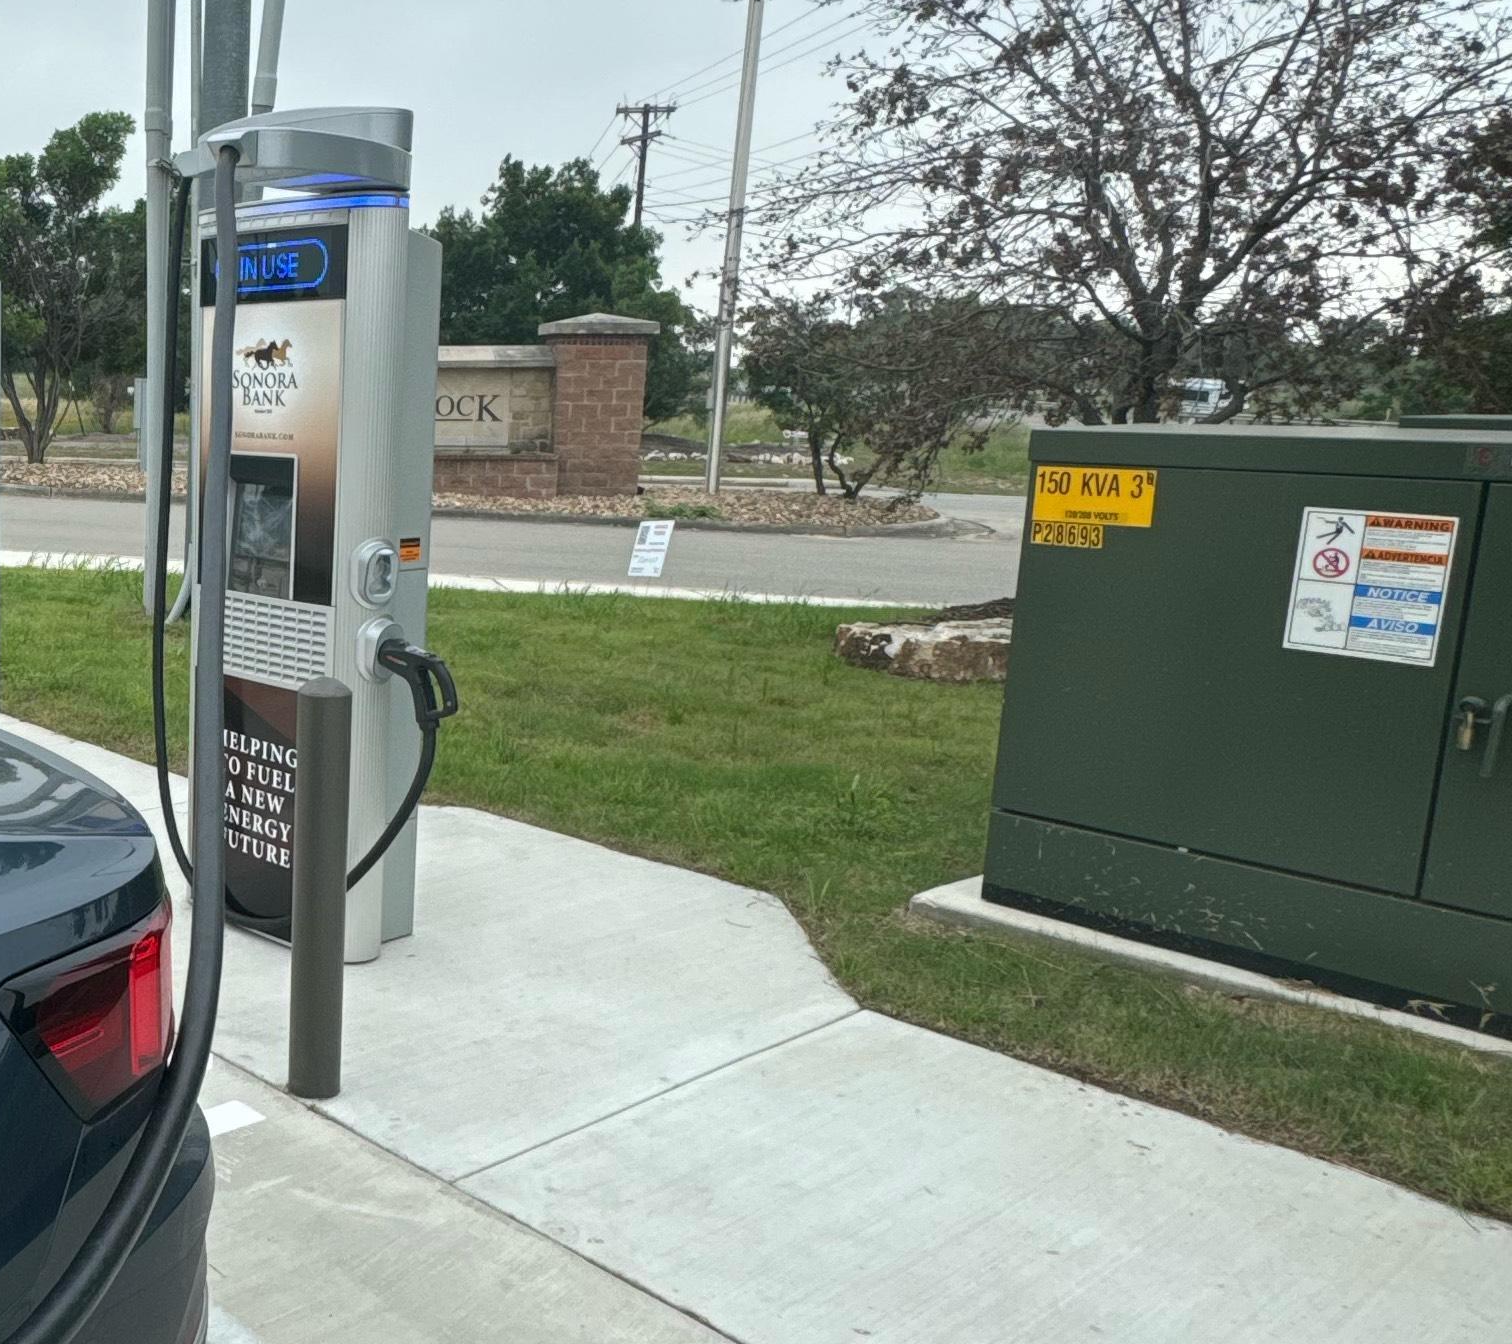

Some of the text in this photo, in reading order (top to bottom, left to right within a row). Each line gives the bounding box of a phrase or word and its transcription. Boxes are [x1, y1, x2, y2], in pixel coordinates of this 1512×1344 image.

[239, 252, 299, 281] IN USE
[231, 369, 299, 389] SONORA
[242, 387, 287, 407] BANK
[1039, 470, 1072, 495] 150
[1081, 472, 1121, 497] KVA
[1032, 522, 1102, 547] P28693
[1382, 518, 1450, 532] WARNING
[1366, 587, 1432, 603] NOTICE
[1365, 618, 1419, 633] AVISO
[246, 761, 296, 793] FUEL
[225, 779, 285, 815] A NEW
